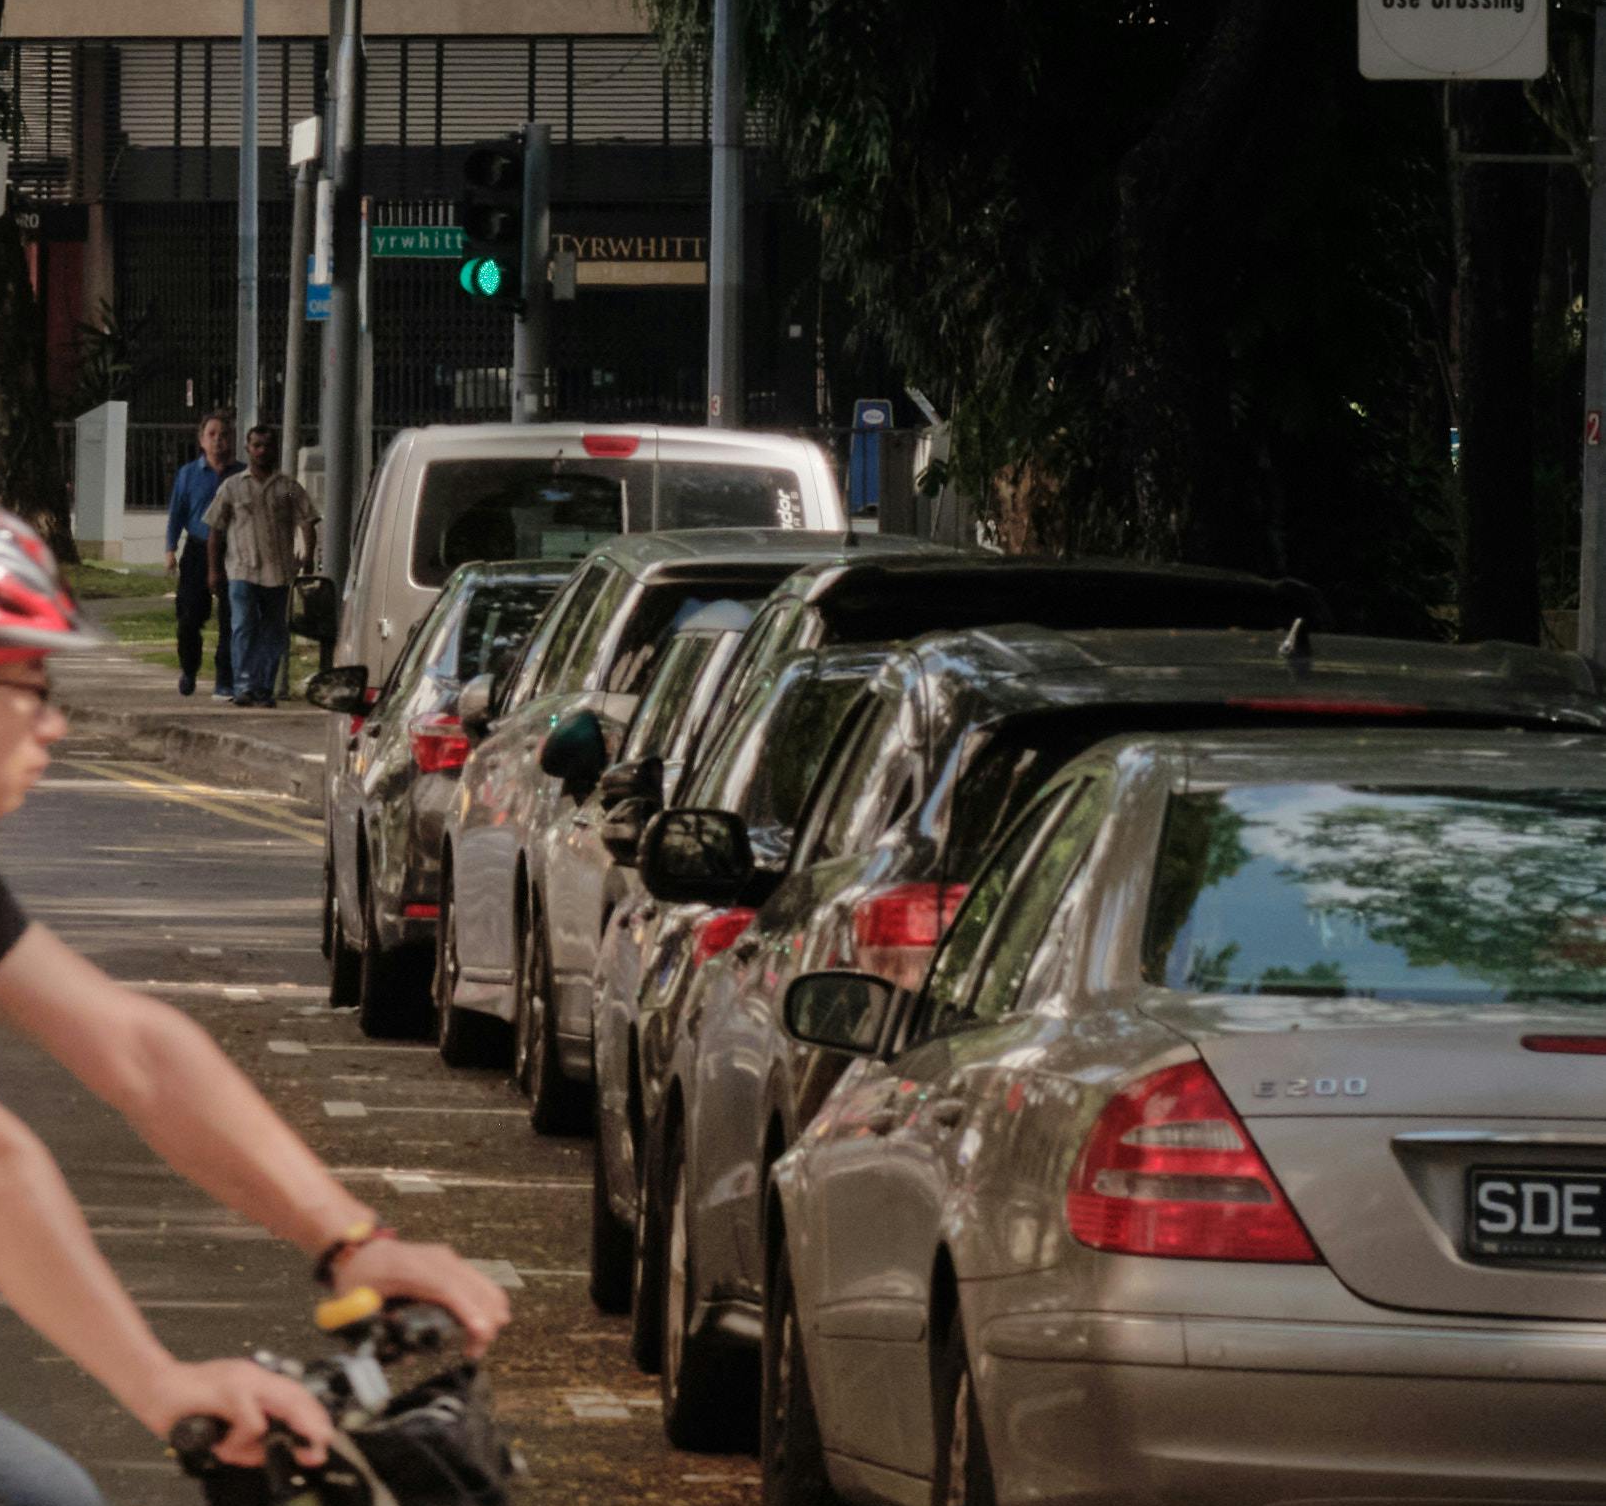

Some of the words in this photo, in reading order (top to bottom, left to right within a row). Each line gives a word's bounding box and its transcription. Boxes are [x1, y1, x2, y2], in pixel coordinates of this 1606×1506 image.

[375, 231, 464, 254] yrwhitt
[551, 233, 707, 258] TYRWHITT
[1588, 412, 1599, 445] 2
[1252, 1079, 1277, 1098] E
[1285, 1077, 1368, 1097] 200
[1477, 1181, 1603, 1236] SDE
